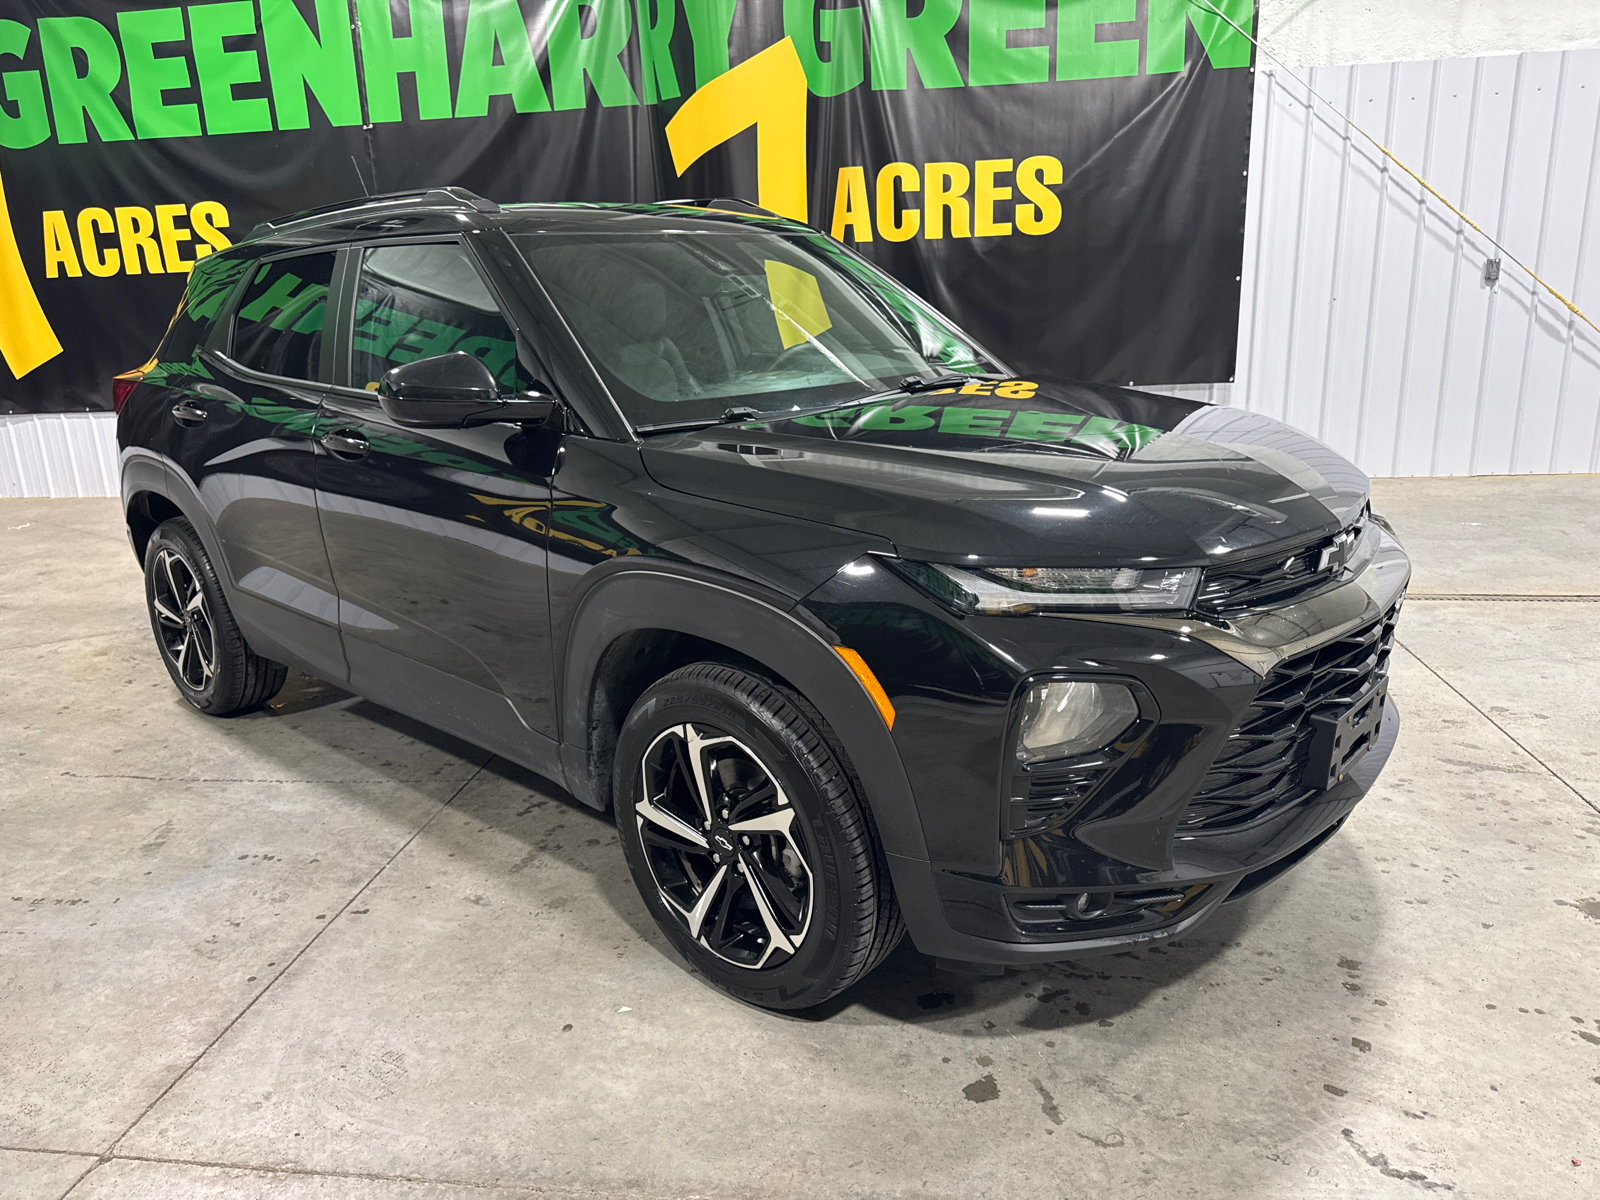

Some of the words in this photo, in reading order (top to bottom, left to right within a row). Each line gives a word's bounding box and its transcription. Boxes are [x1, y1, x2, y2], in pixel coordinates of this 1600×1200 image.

[782, 0, 1254, 97] GREEN
[43, 200, 232, 280] ACRES
[830, 155, 1064, 243] ACRES
